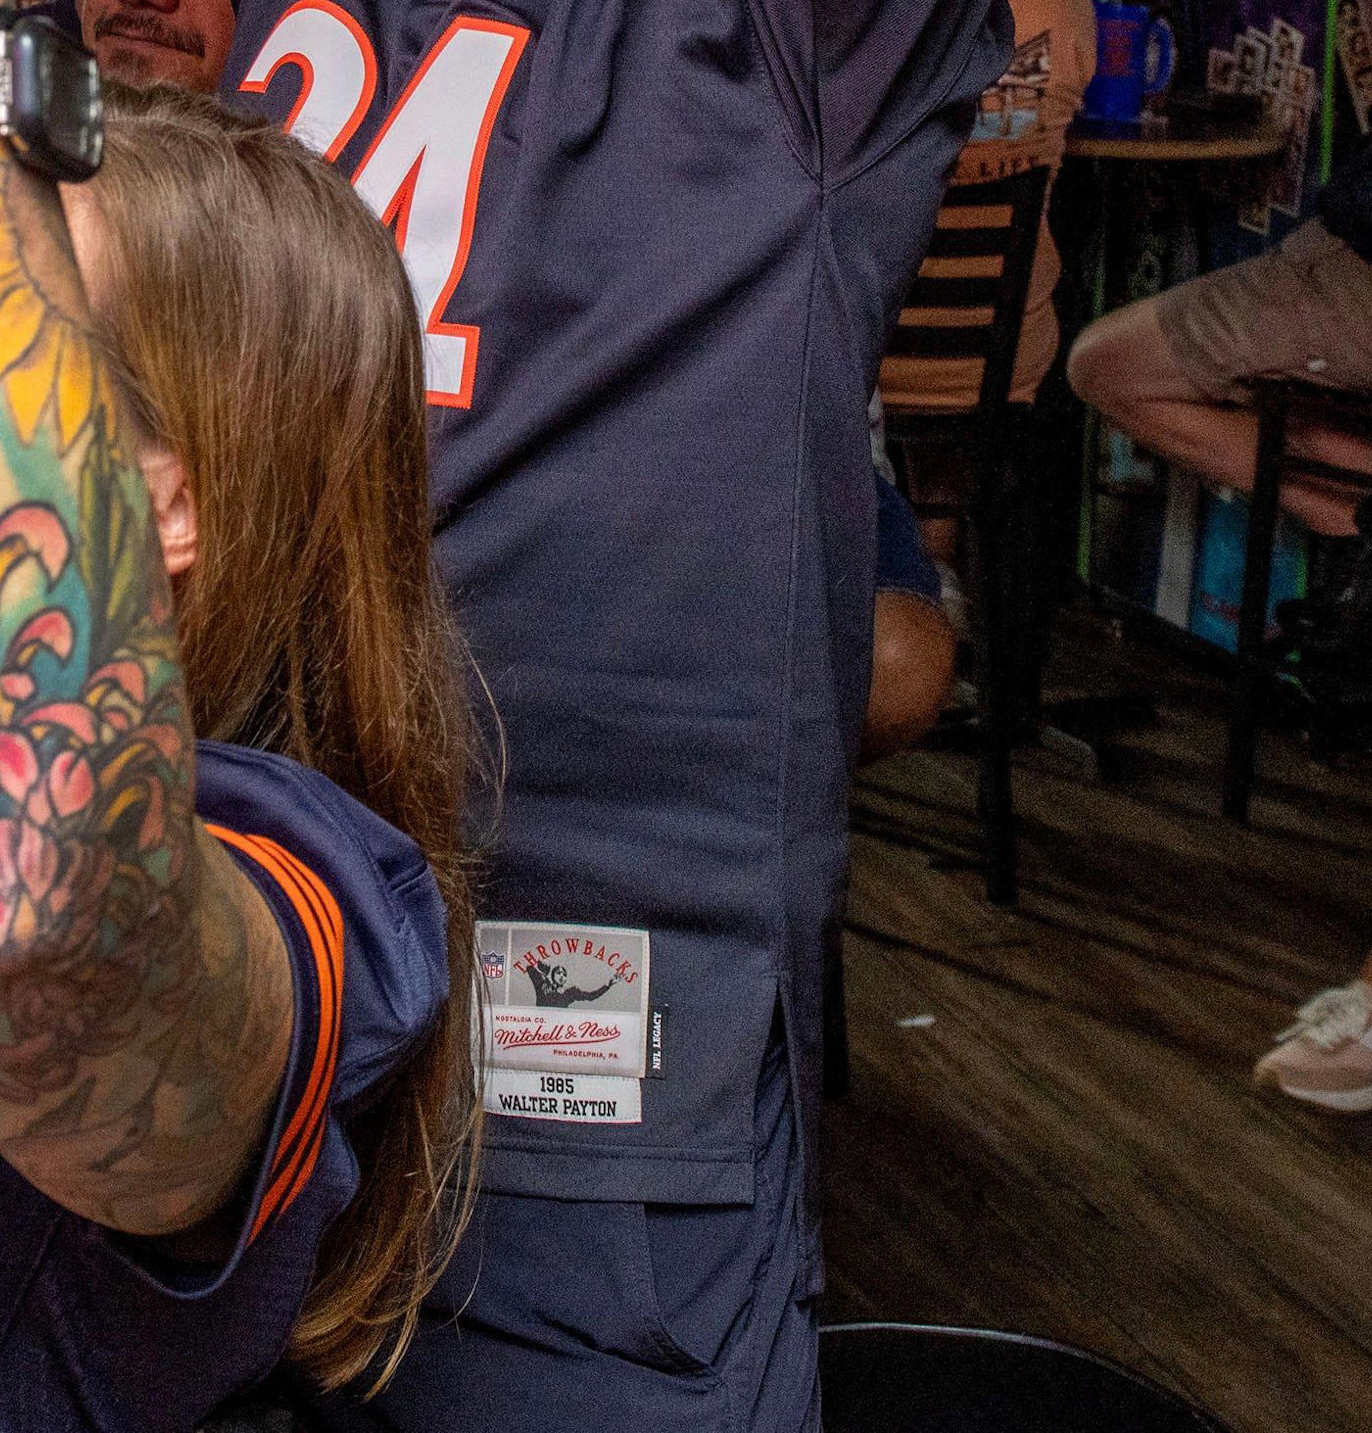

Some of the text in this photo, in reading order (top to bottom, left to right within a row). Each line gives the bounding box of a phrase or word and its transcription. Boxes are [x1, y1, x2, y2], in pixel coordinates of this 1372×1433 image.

[483, 963, 504, 978] NFL
[513, 938, 639, 984] THROWBACKS
[533, 1017, 547, 1025] CO.
[652, 1012, 663, 1048] LEGACY
[494, 1021, 621, 1047] Mitchell & Ness
[540, 1076, 575, 1094] 1985
[498, 1093, 618, 1117] WALTER PAYTON
